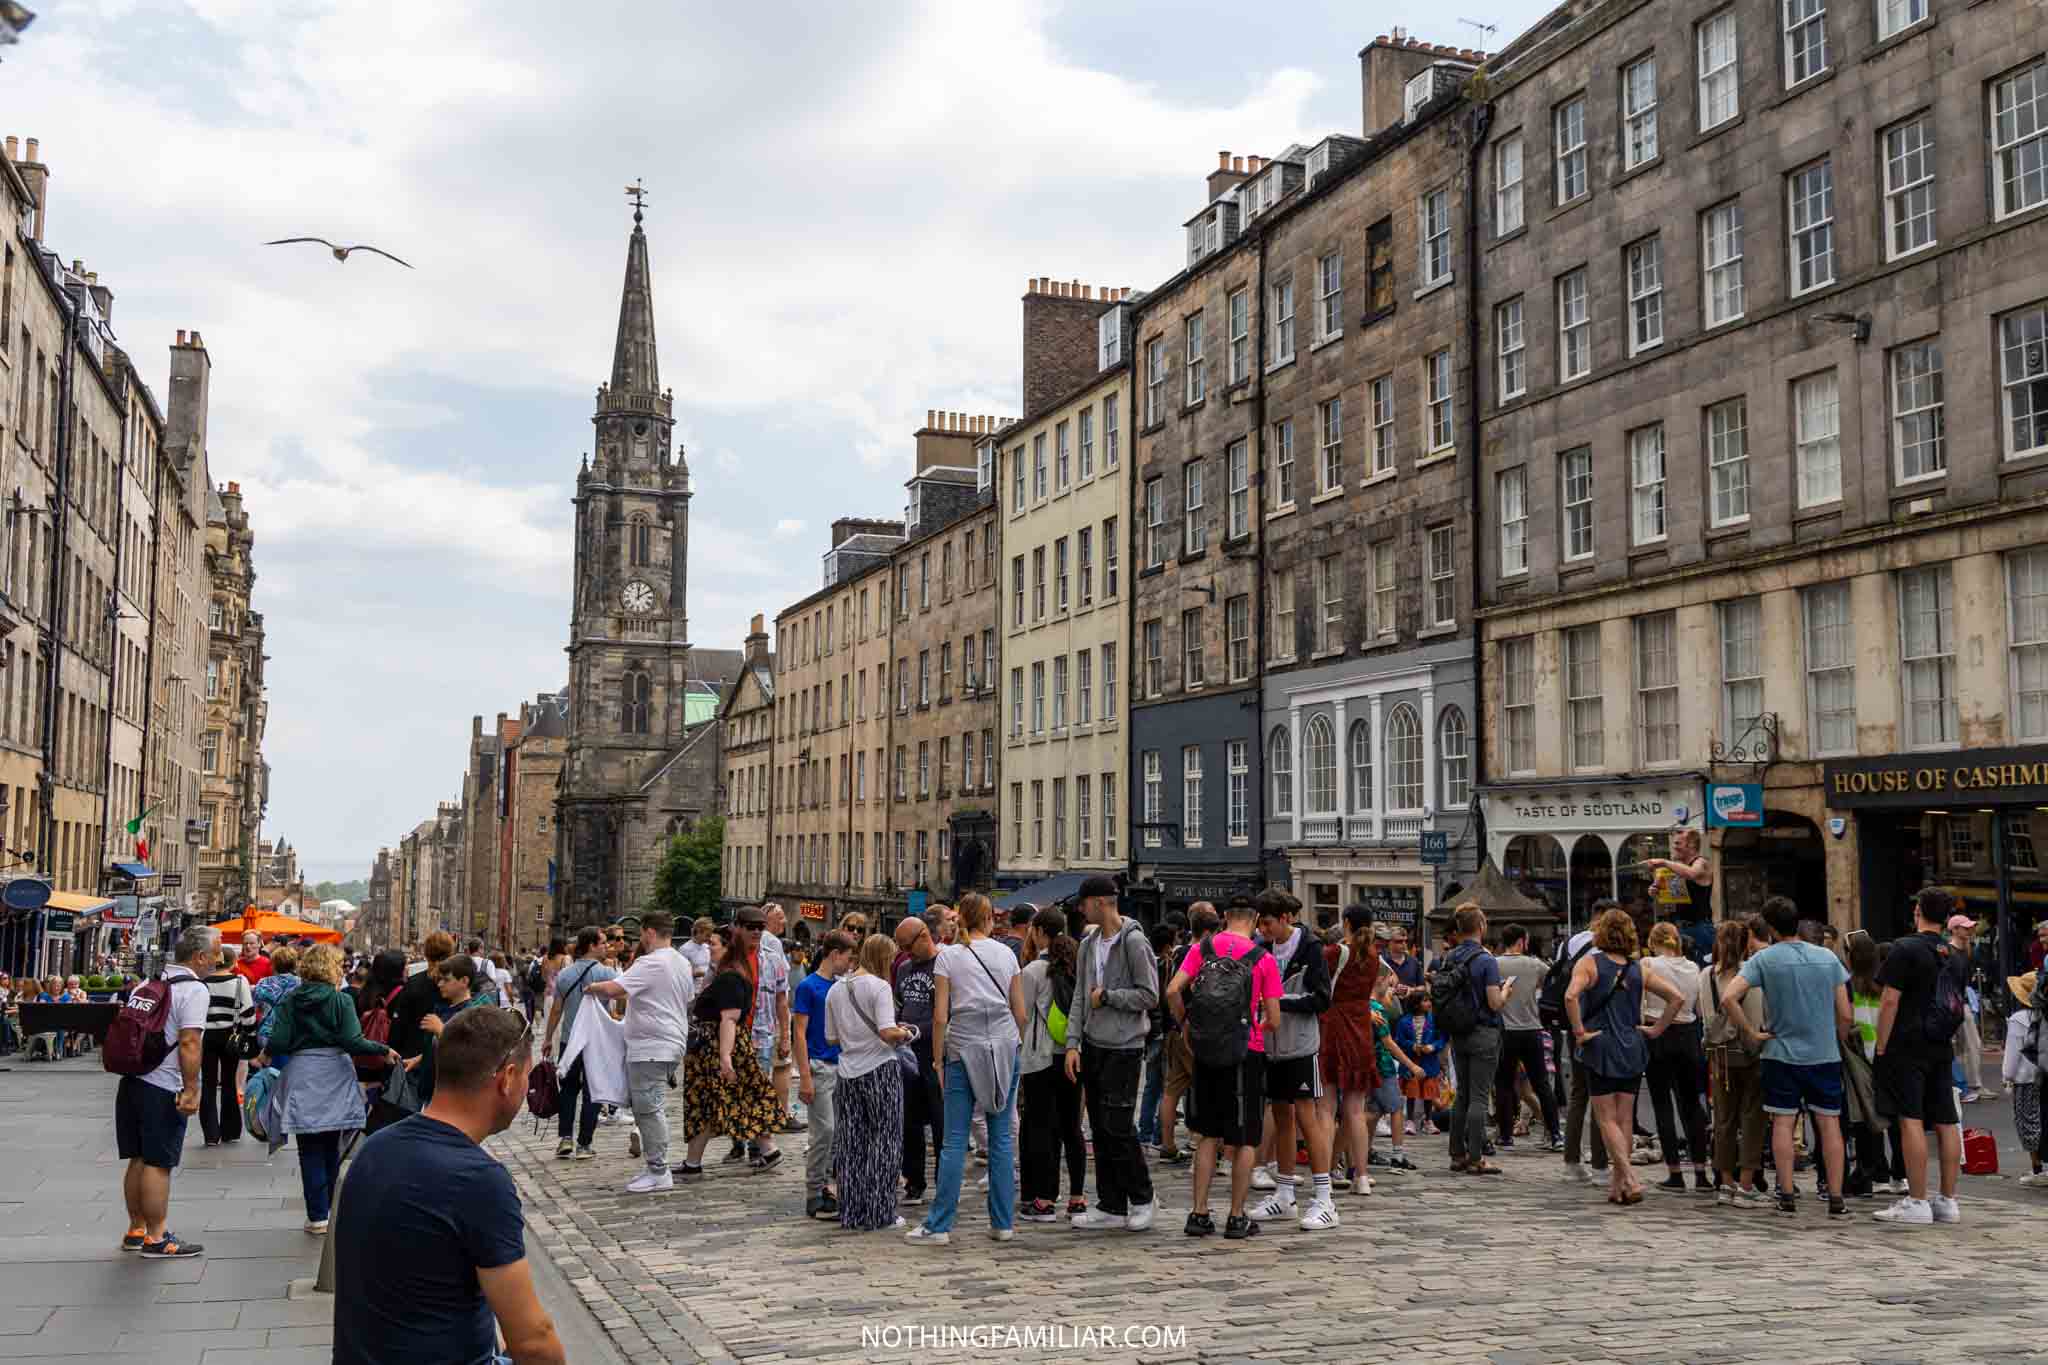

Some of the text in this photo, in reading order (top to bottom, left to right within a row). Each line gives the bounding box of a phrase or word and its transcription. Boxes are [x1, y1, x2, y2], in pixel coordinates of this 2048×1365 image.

[1833, 770, 1909, 793] HOUSE
[1916, 767, 1947, 790] OF
[1516, 802, 1662, 817] TASTE OF SCOTLAND
[1422, 837, 1444, 849] 166
